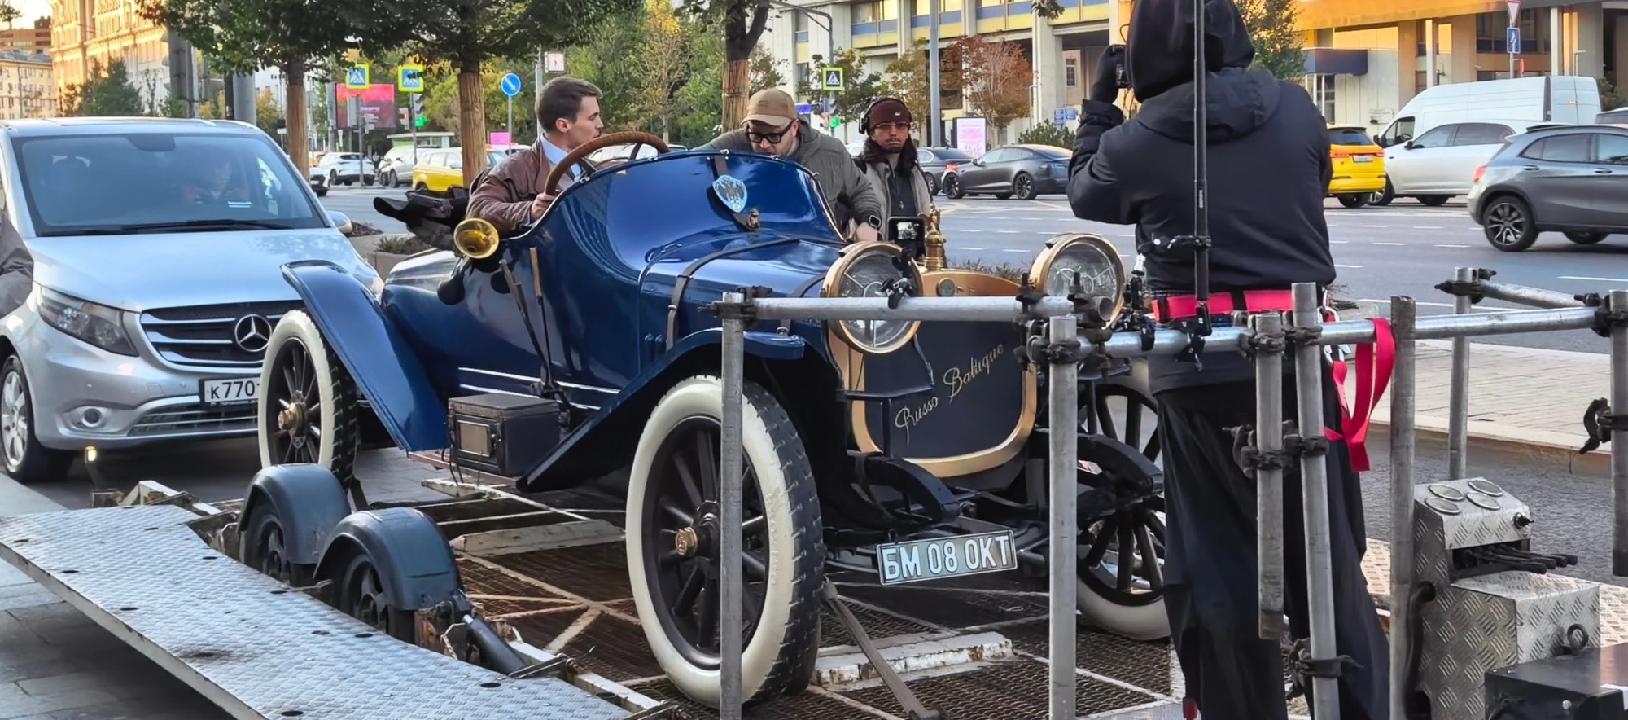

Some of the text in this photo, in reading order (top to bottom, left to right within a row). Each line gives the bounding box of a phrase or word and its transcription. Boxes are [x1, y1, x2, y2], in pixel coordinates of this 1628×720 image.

[210, 380, 260, 399] К770
[895, 396, 939, 445] Russo
[882, 535, 1009, 580] БМ 08 ОКТ
